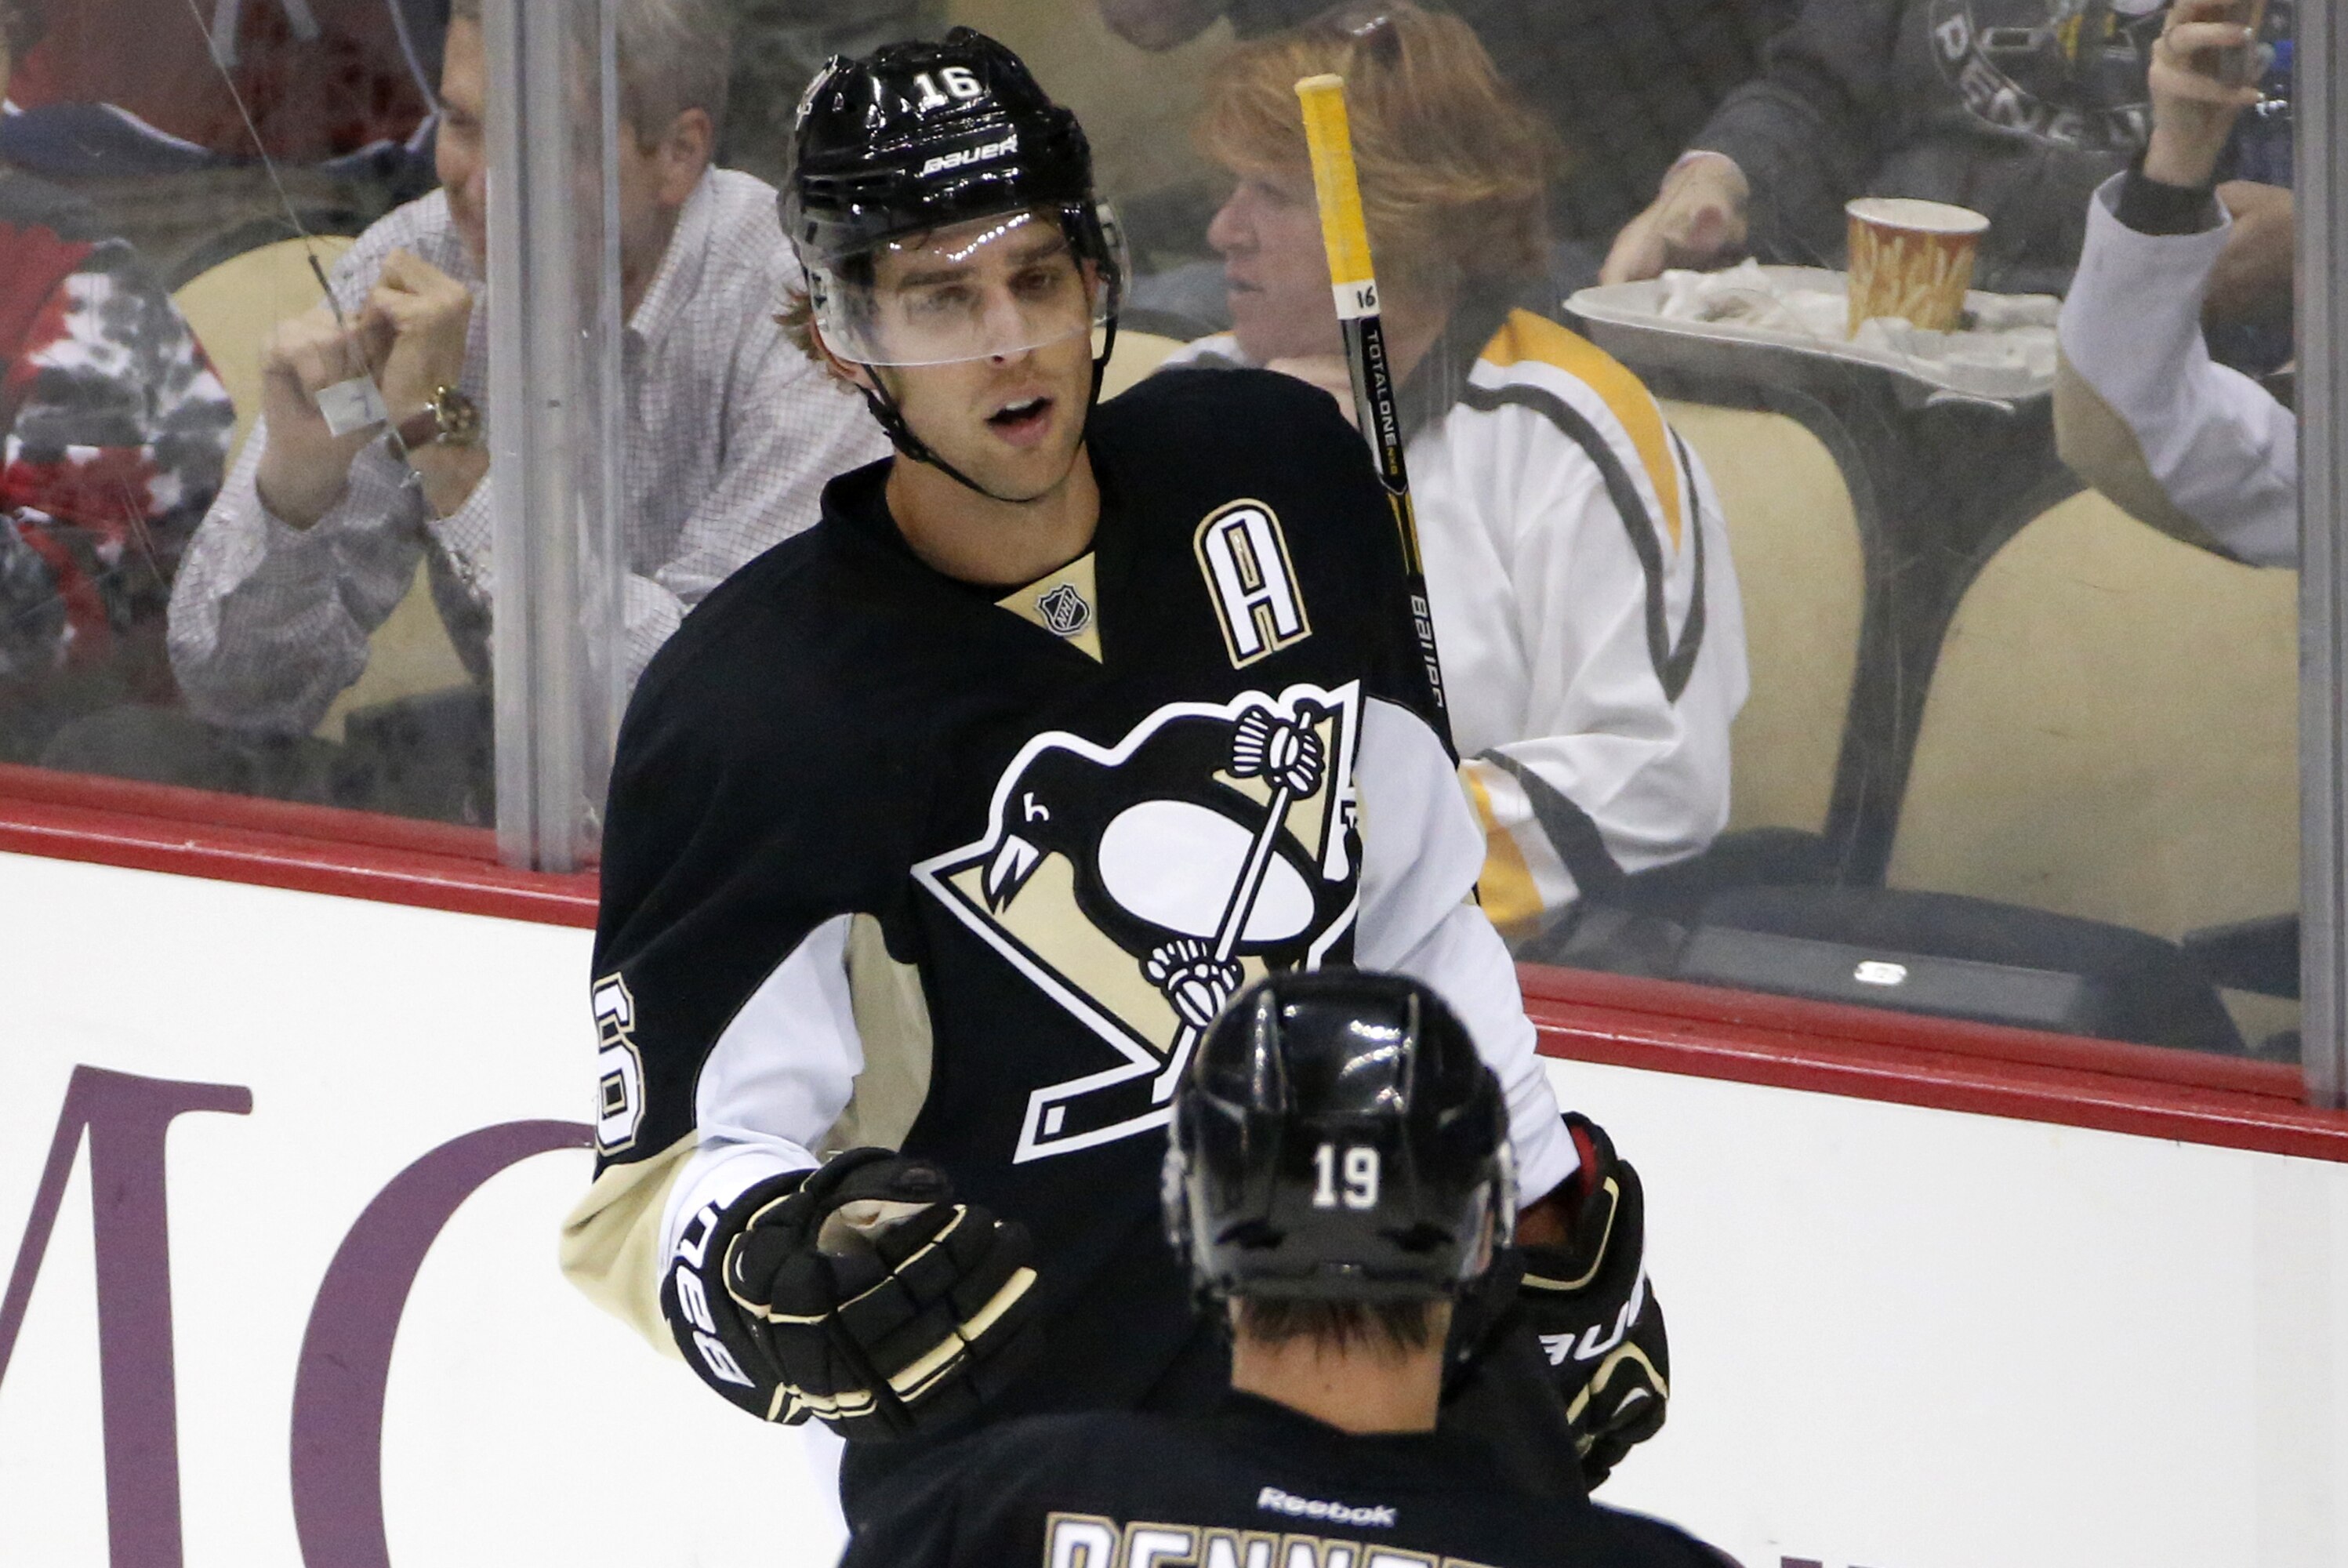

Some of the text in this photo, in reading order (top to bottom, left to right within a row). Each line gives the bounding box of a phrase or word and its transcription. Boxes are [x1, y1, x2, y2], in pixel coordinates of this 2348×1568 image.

[914, 67, 982, 111] 16
[923, 134, 1018, 175] BAUER
[1357, 287, 1377, 309] 16
[1193, 497, 1312, 670] A
[1312, 1142, 1381, 1209] 19
[676, 1205, 757, 1388] BAU
[1257, 1486, 1398, 1528] Reebok
